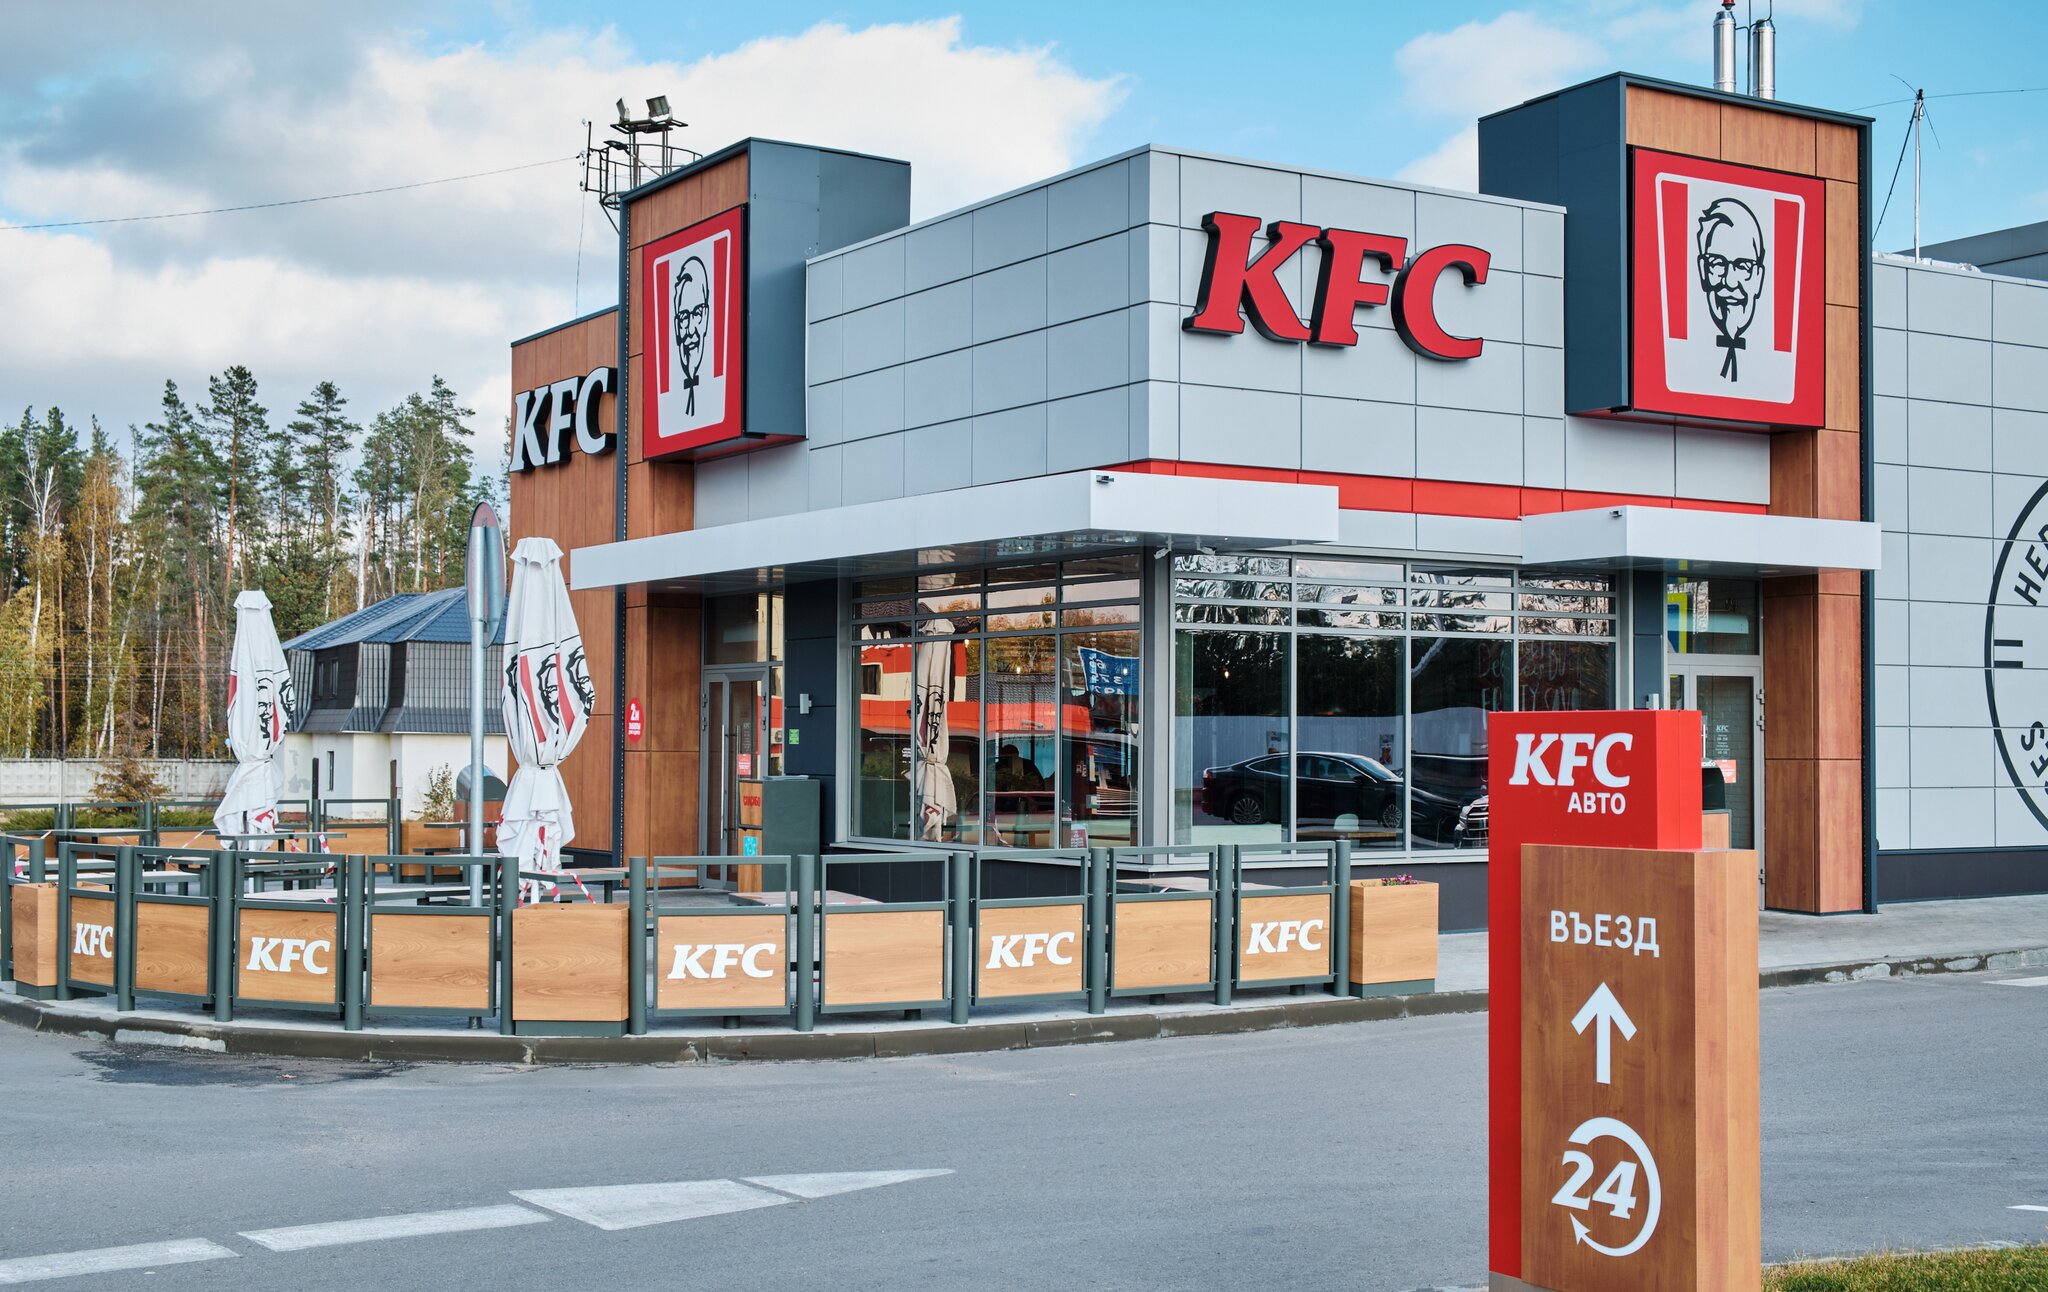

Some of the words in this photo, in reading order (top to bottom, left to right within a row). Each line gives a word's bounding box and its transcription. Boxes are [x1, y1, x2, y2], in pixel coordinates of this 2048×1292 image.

[1186, 212, 1491, 359] KFC
[510, 366, 613, 472] KFC
[1509, 733, 1633, 787] KFC
[1567, 791, 1626, 815] АВТО
[74, 922, 114, 958] KFC
[986, 931, 1076, 970] KFC
[1242, 918, 1325, 956] KFC
[1550, 910, 1660, 958] ВЪЕЗД
[246, 936, 331, 975] KFC
[667, 943, 777, 980] KFC
[1551, 1150, 1638, 1220] 24
